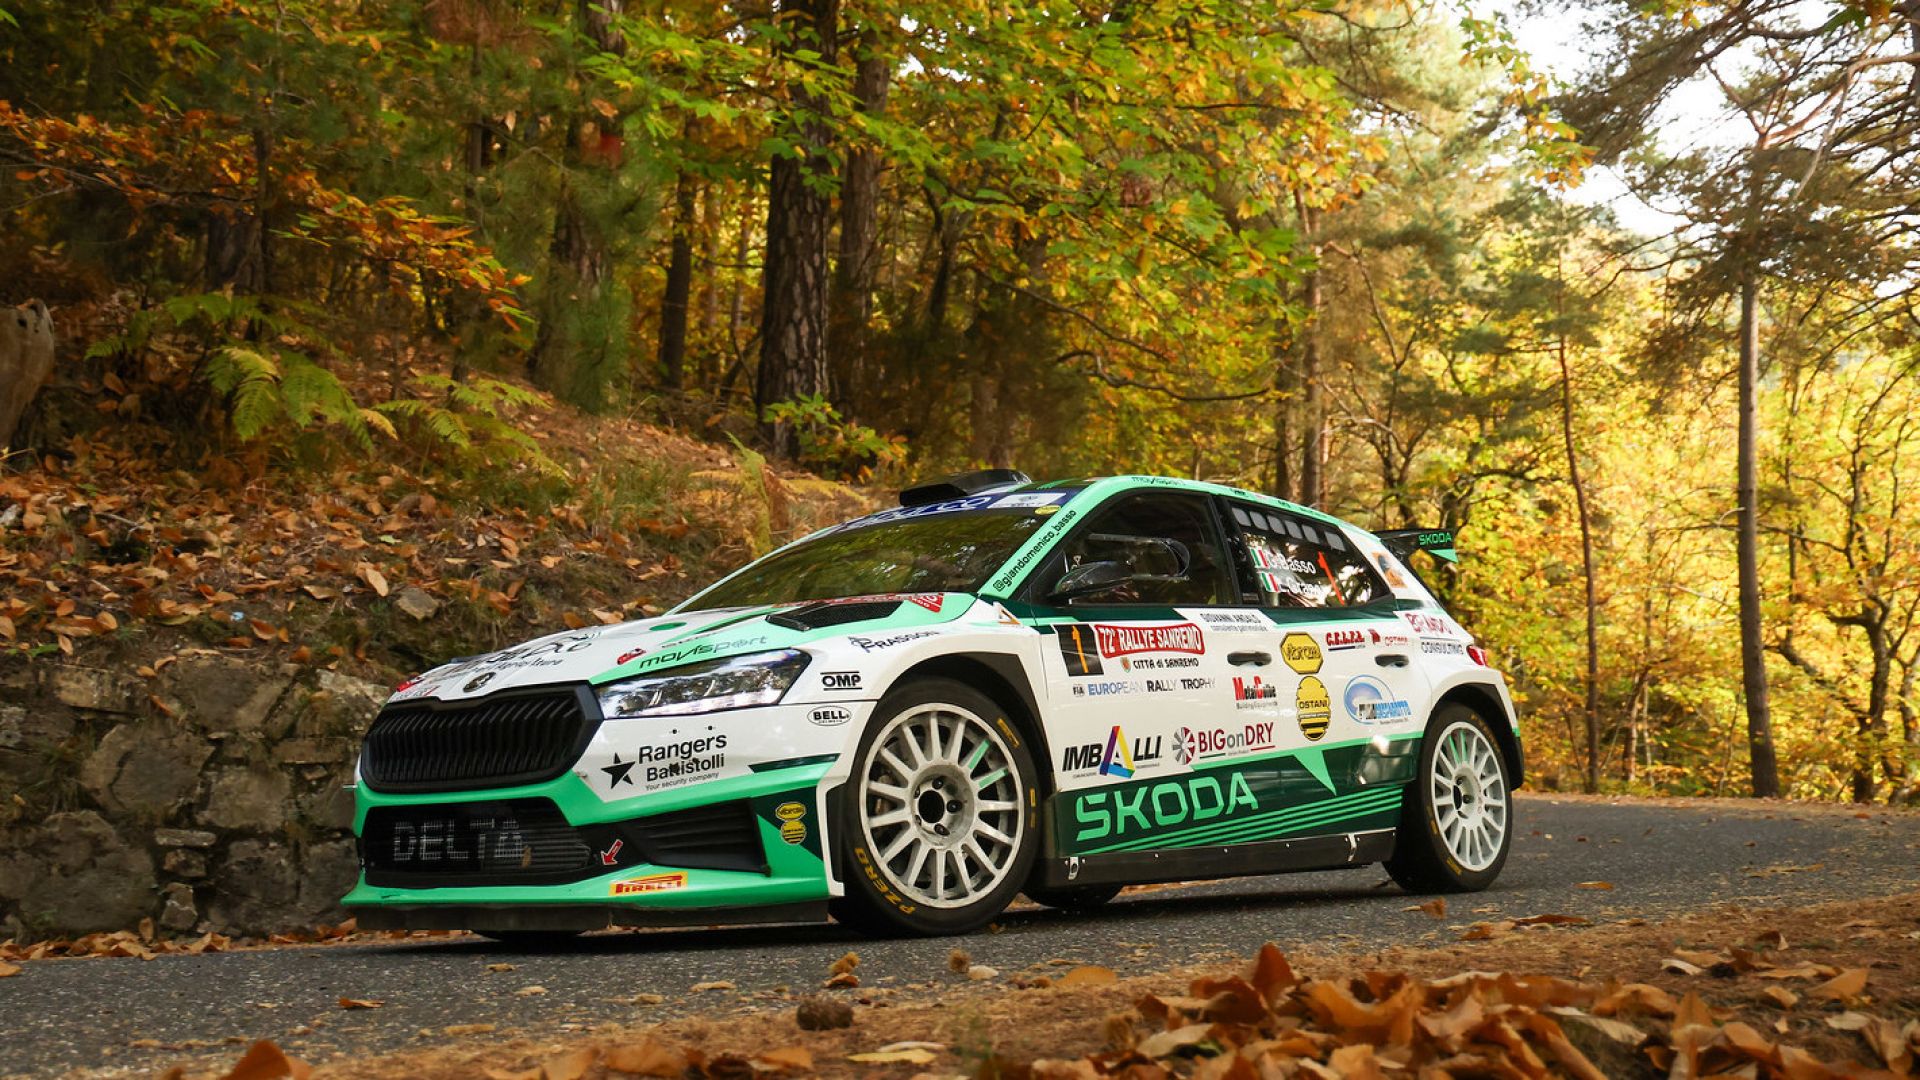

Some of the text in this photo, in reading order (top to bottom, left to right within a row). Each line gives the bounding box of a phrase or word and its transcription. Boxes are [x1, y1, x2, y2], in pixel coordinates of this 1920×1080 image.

[993, 510, 1077, 592] @giandomenico_basso
[1119, 629, 1156, 650] RALLYE
[1156, 626, 1202, 650] SANREMO
[1072, 625, 1089, 673] 1
[1165, 657, 1199, 668] SANREMO
[822, 675, 861, 687] OMP
[1088, 682, 1144, 696] EUROPEAN
[1146, 679, 1176, 693] RALLY
[1181, 677, 1215, 690] TROPHY
[813, 711, 846, 720] BELL
[639, 734, 727, 764] Rangers
[645, 772, 719, 791] Your security company
[394, 819, 525, 861] DELTA
[616, 875, 683, 893] PIRELLI
